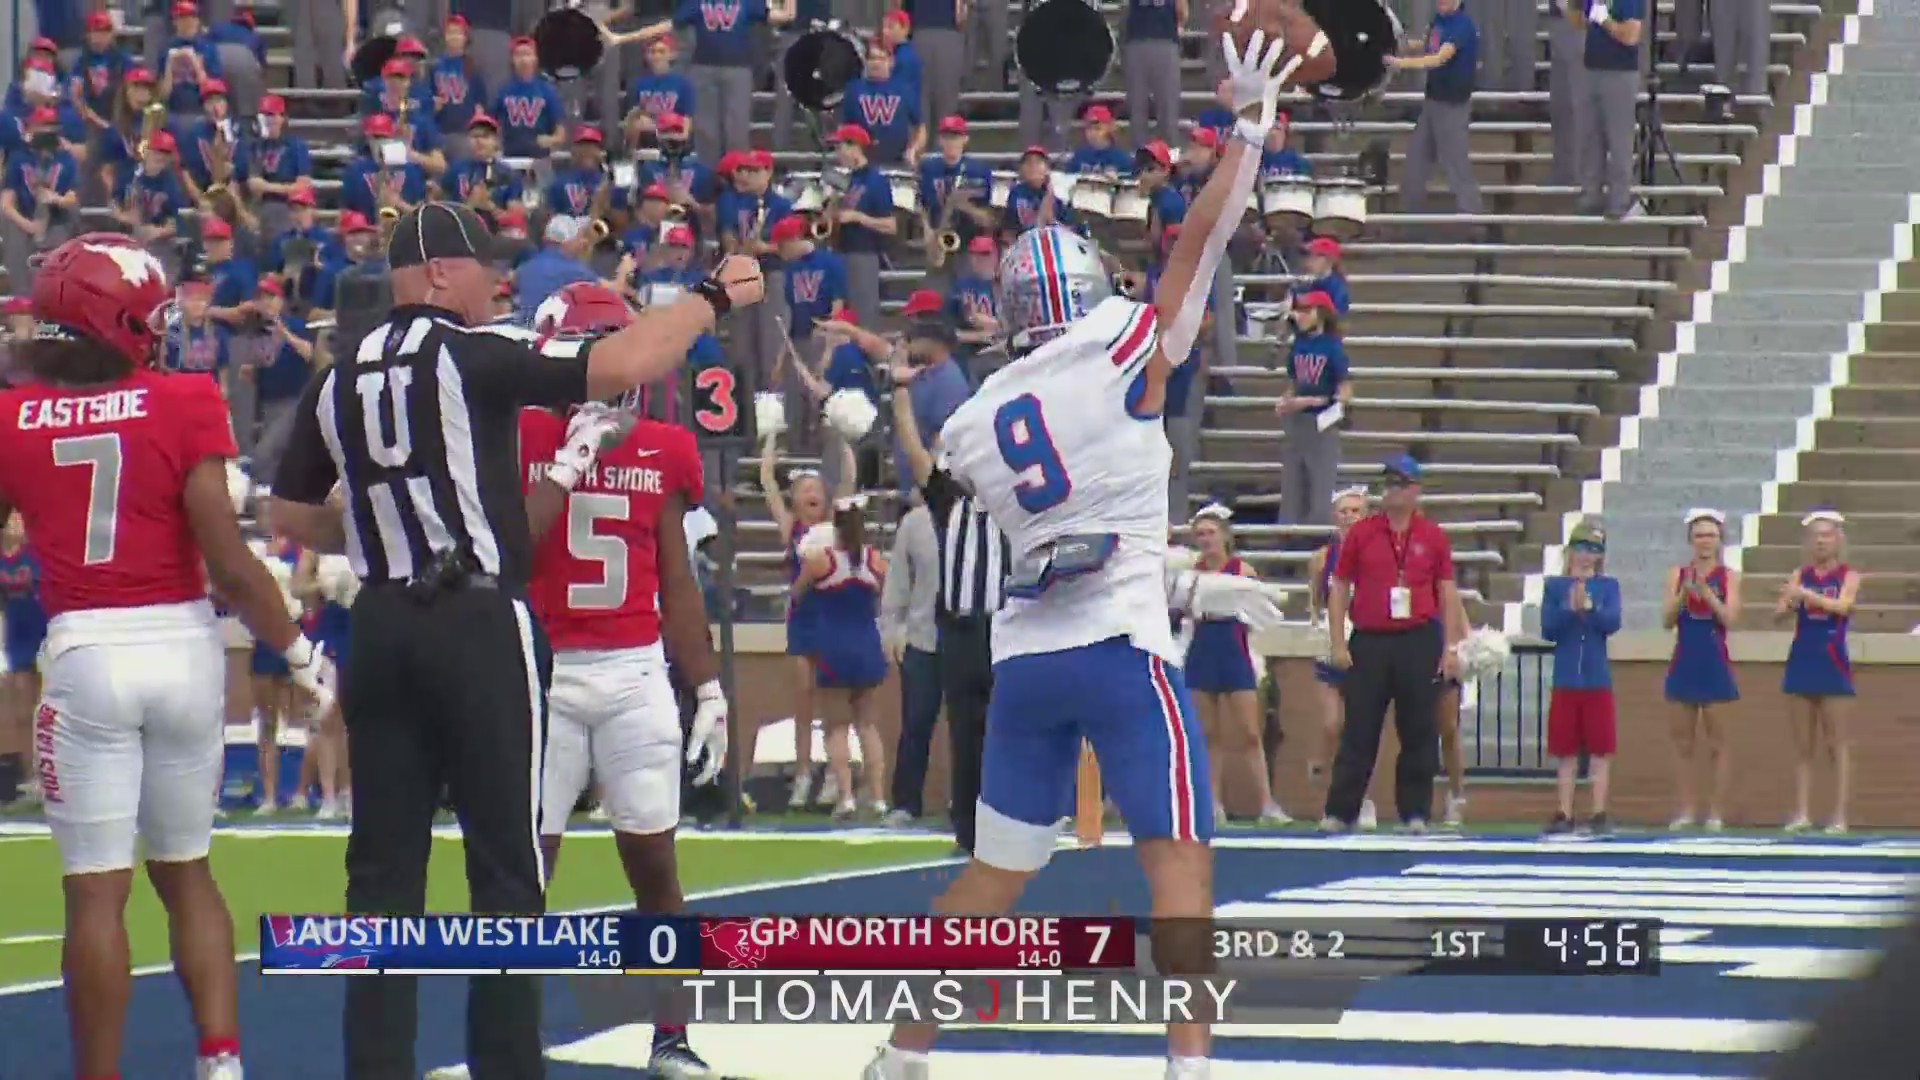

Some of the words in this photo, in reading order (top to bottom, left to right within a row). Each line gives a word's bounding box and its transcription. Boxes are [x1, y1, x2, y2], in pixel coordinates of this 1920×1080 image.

[700, 0, 740, 31] W
[435, 73, 469, 104] W
[504, 96, 546, 127] W
[859, 94, 901, 125] W
[792, 269, 825, 304] W
[1294, 352, 1329, 386] W
[18, 389, 149, 430] EASTSIDE
[356, 365, 413, 468] U
[695, 366, 738, 432] 3
[994, 392, 1073, 514] 9
[604, 465, 663, 494] SHORE
[52, 432, 123, 565] 7
[567, 492, 630, 609] 5
